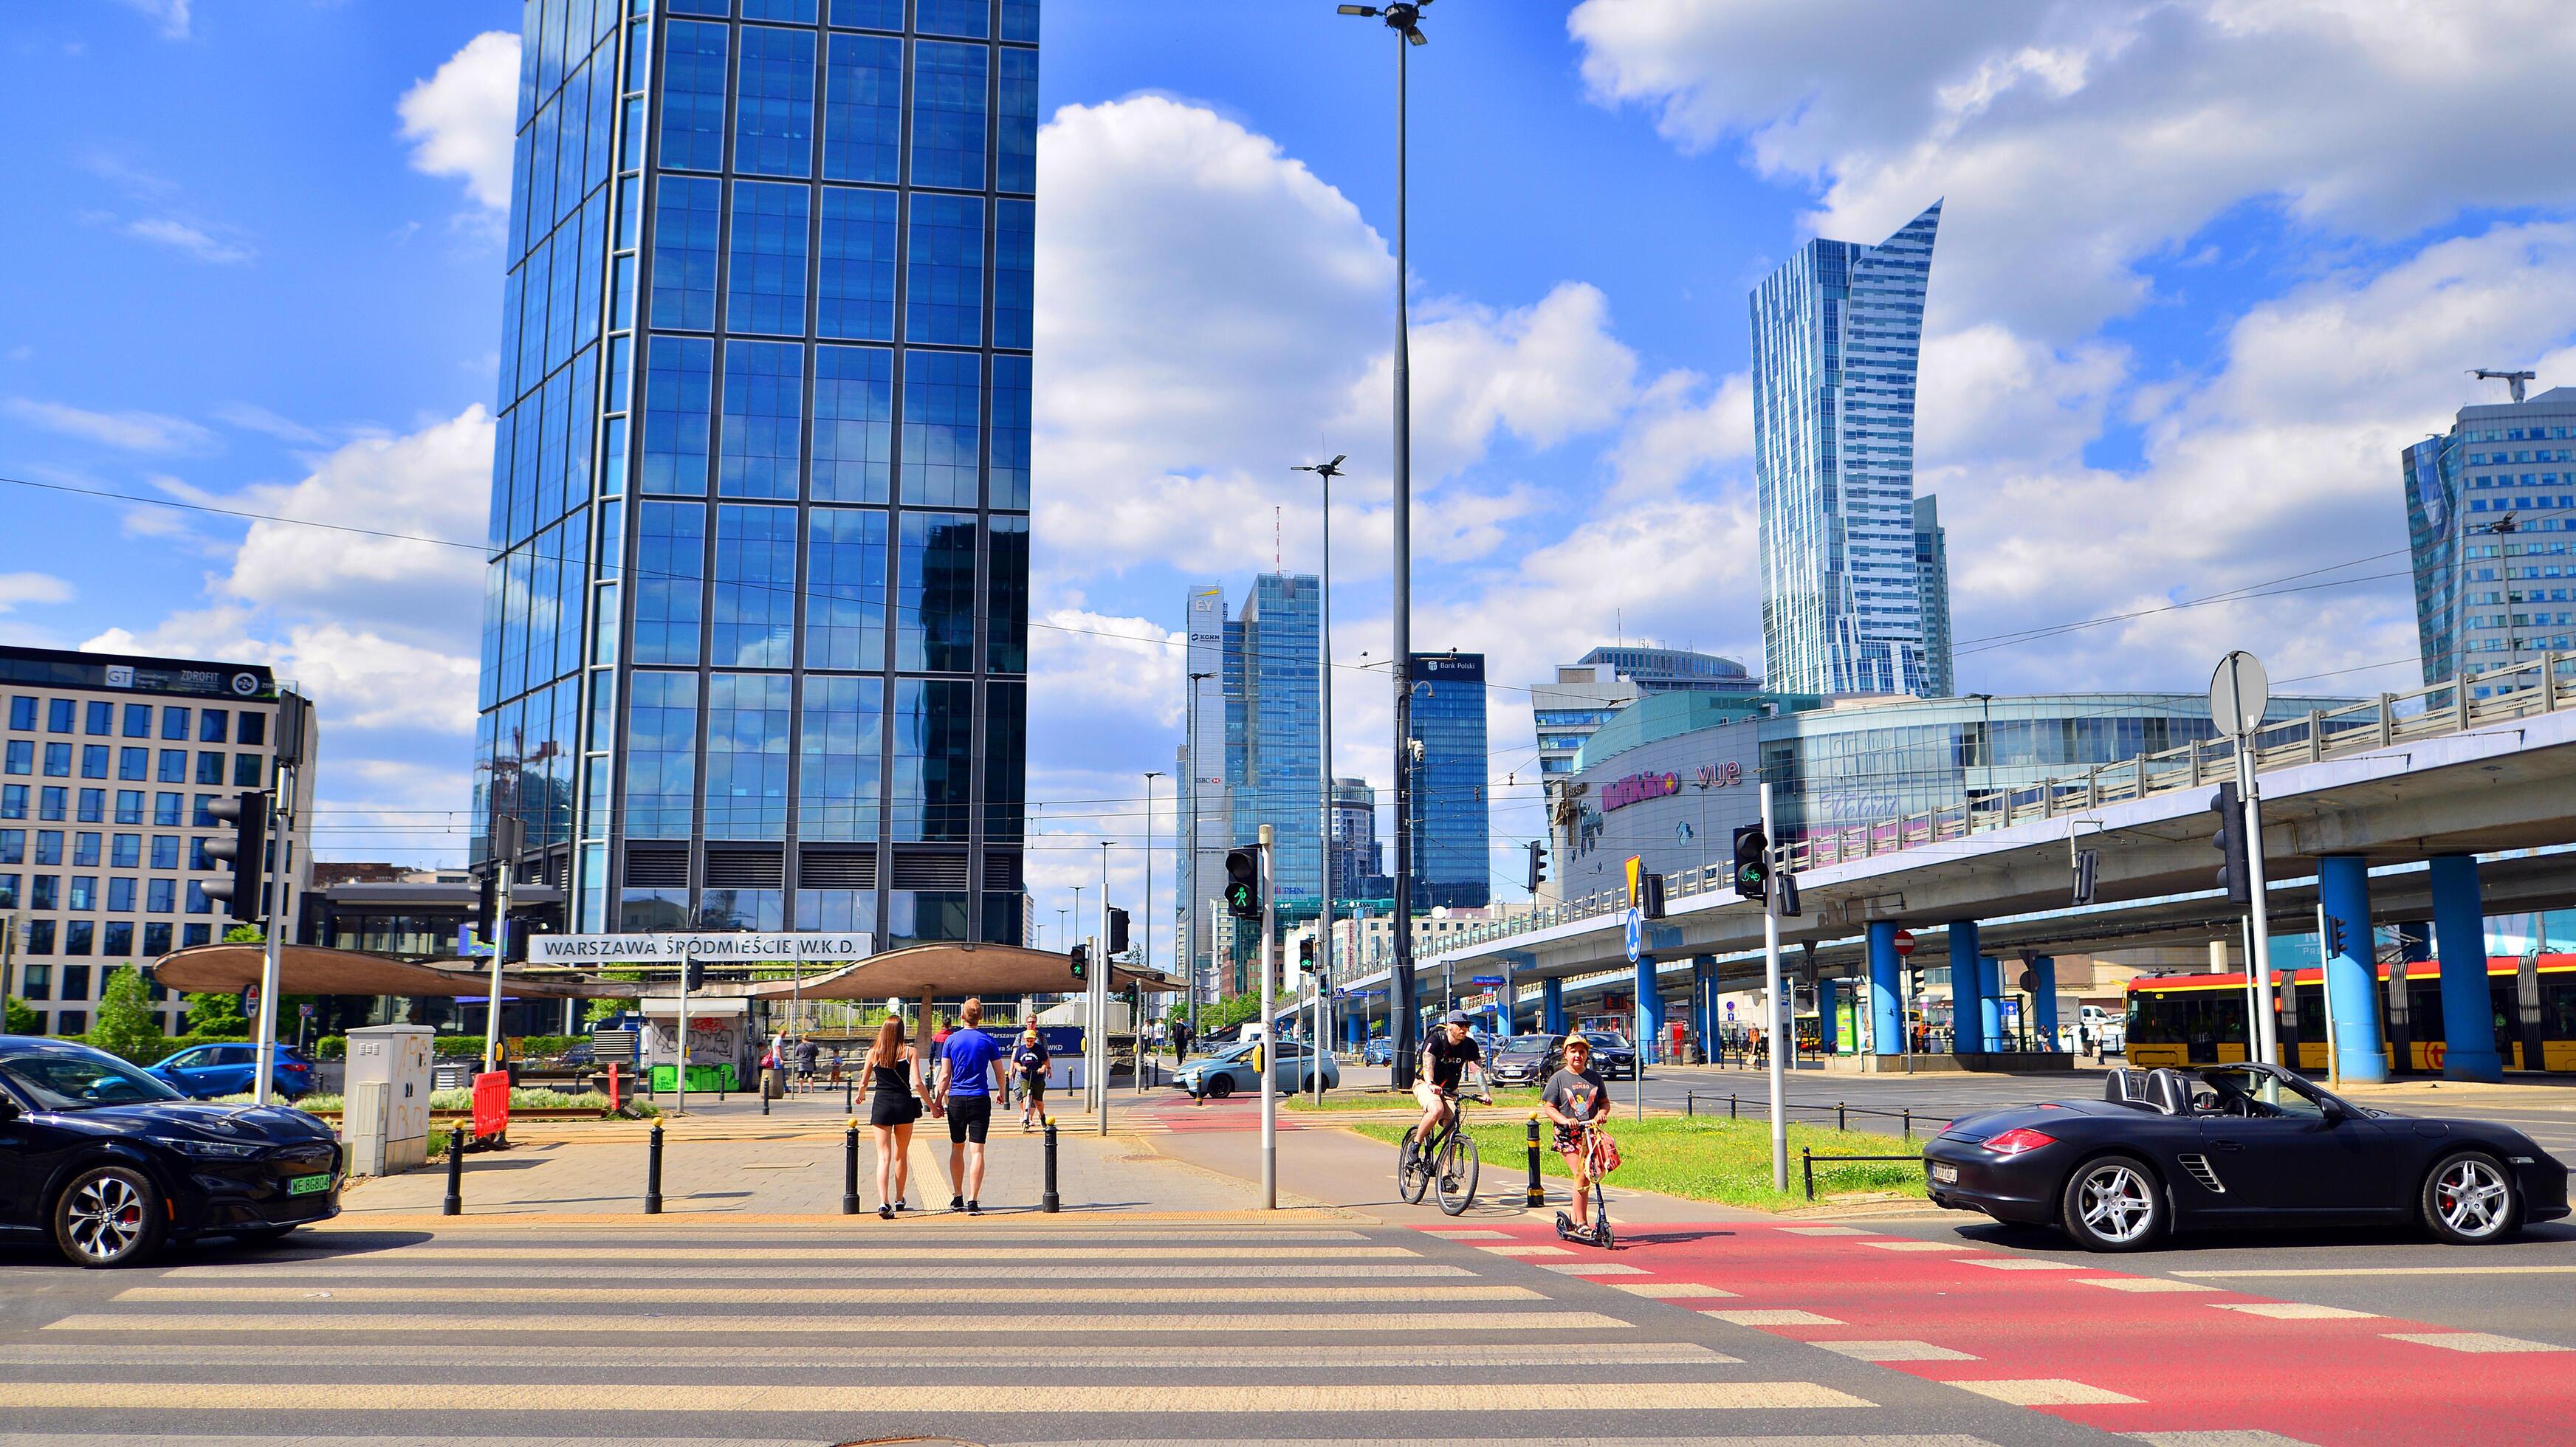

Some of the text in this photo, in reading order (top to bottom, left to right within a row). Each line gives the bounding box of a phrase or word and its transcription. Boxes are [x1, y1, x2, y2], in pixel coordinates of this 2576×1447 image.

[1195, 599, 1212, 611] EY
[108, 670, 131, 682] GT
[180, 670, 220, 681] ZDROFIT
[1694, 760, 1741, 788] vue
[1601, 770, 1679, 813] Multikino
[544, 935, 856, 955] WARSZAWA ŚRÓDMIEŚCIE W.K.D.
[292, 1176, 329, 1193] WE 8G804
